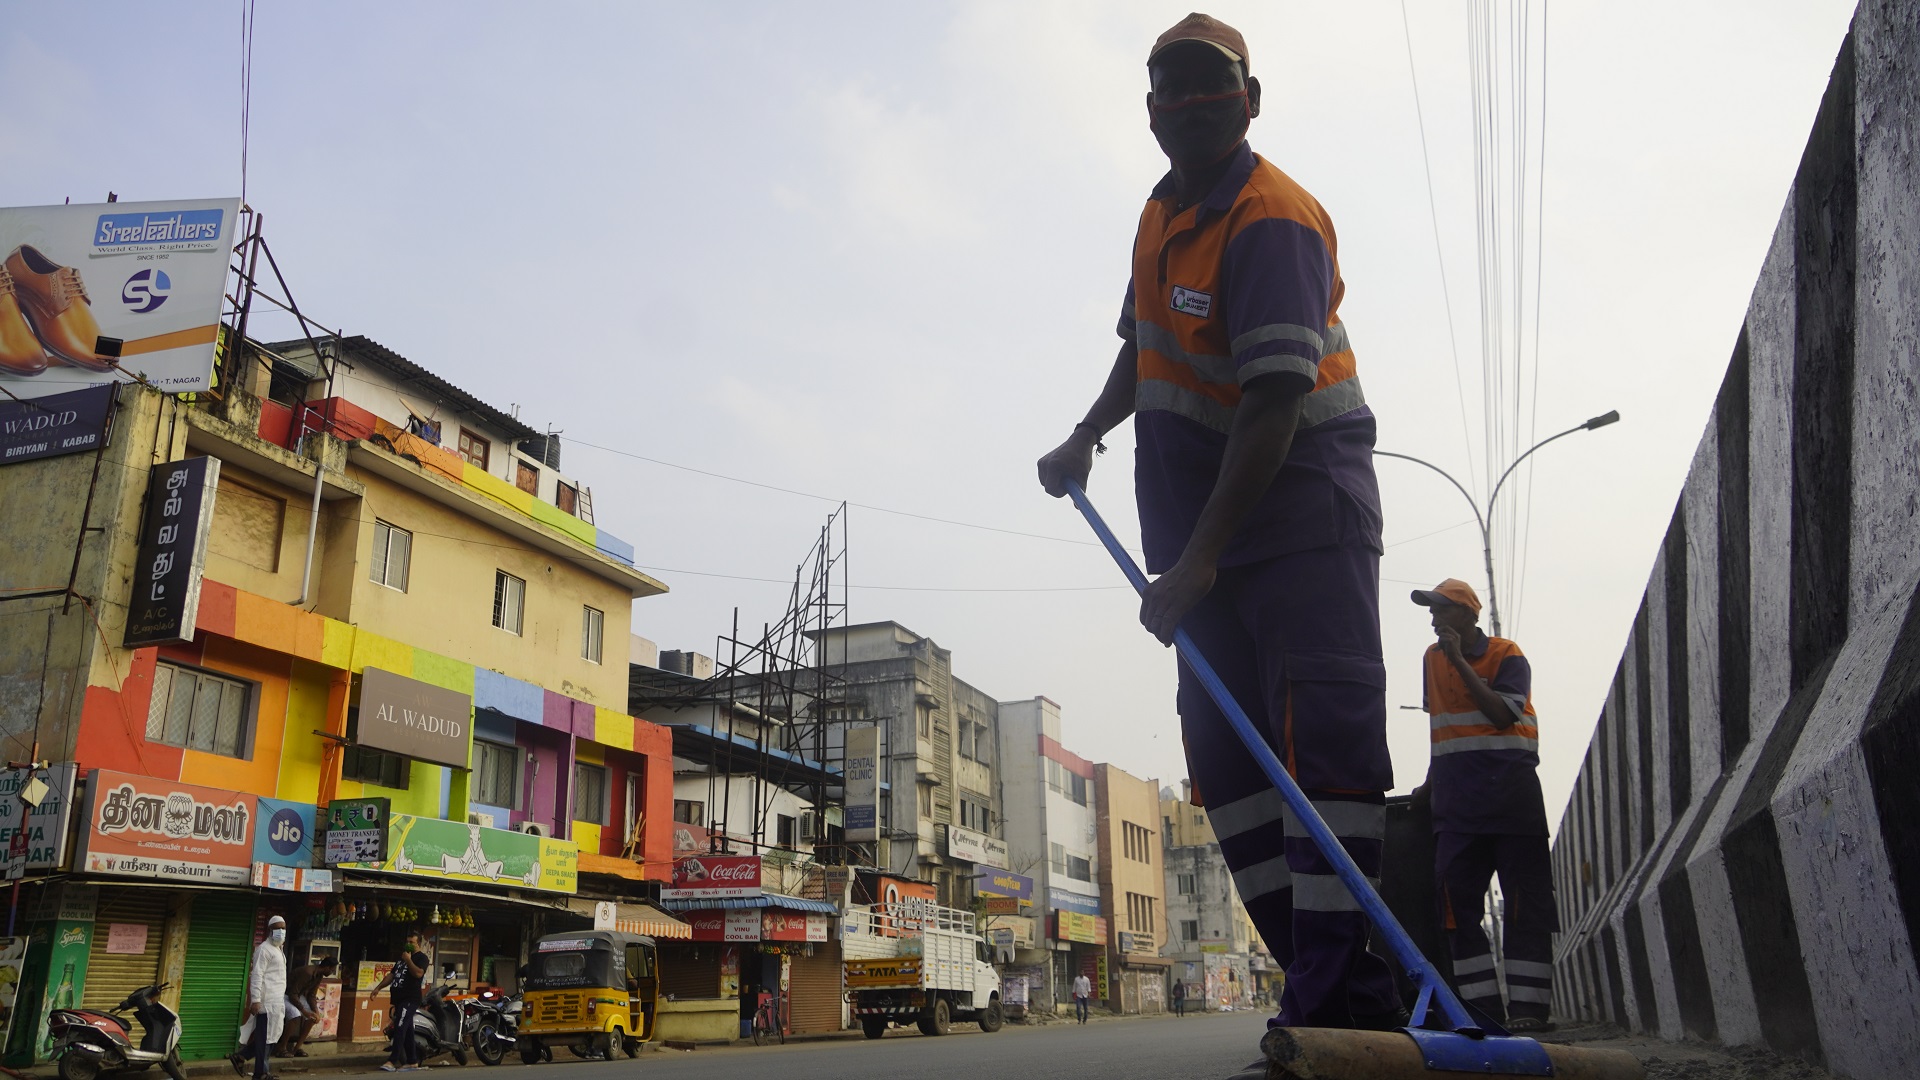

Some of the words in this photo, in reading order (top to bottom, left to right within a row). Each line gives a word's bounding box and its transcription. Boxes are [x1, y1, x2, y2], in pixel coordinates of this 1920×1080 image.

[99, 214, 217, 243] Sreeleathers
[172, 376, 201, 385] NAGAR
[5, 410, 77, 435] WADUD
[62, 433, 96, 448] KABAB
[376, 703, 399, 724] AL
[402, 708, 461, 738] WADUD
[847, 757, 875, 770] DENTAL
[849, 769, 873, 781] CLINIC
[271, 820, 301, 843] Jio
[329, 831, 350, 839] MONEY
[351, 830, 380, 838] TRANSFER
[545, 868, 560, 876] DEEPA
[560, 870, 577, 879] SNACK
[555, 878, 566, 886] BAR
[987, 901, 1017, 909] ROOMS
[80, 911, 93, 919] BAR
[60, 932, 85, 944] Sprite
[868, 967, 897, 977] TATA
[1098, 957, 1106, 998] XEROX
